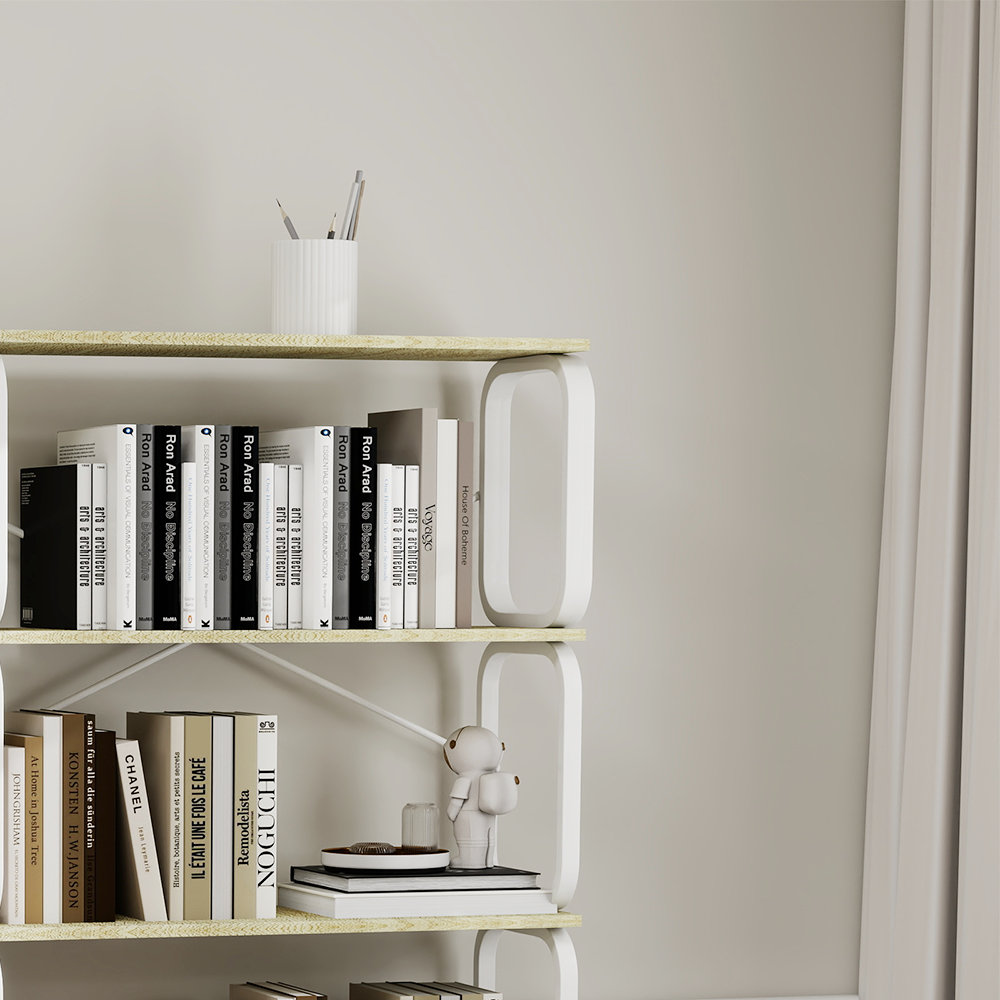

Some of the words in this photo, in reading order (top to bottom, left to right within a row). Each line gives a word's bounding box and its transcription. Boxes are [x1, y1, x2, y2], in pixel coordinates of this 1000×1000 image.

[141, 433, 152, 458] Ron
[165, 434, 177, 459] Ron
[219, 434, 230, 459] Ron
[243, 435, 254, 460] Ron
[338, 434, 349, 459] Ron
[362, 435, 373, 461] Ron
[141, 462, 152, 491] Arad
[165, 463, 177, 492] Arad
[219, 463, 230, 492] Arad
[243, 463, 254, 493] Arad
[338, 464, 349, 492] Arad
[362, 464, 373, 494] Arad
[79, 505, 90, 523] arts
[94, 506, 106, 523] arts
[165, 501, 177, 519] No
[243, 501, 254, 519] No
[361, 501, 373, 520] No
[462, 517, 469, 527] Of
[421, 504, 436, 552] Voyage
[79, 536, 92, 587] architecture
[94, 536, 107, 586] architecture
[163, 522, 177, 581] Discipline
[240, 522, 254, 582] Discipline
[359, 522, 373, 582] Discipline
[31, 755, 39, 767] At
[188, 757, 206, 782] CAFÉ
[31, 770, 39, 798] Home
[68, 752, 79, 815] KONSTEN
[87, 766, 96, 785] alla
[124, 754, 142, 814] CHANEL
[87, 787, 96, 802] die
[174, 798, 180, 806] et
[191, 784, 206, 796] LE
[31, 801, 38, 809] in
[191, 797, 206, 819] FOIS
[29, 811, 39, 843] Joshua
[173, 822, 181, 857] botanique,
[191, 821, 206, 840] UNE
[236, 789, 250, 866] Remodelista
[257, 769, 275, 888] NOGUCHI
[31, 845, 39, 866] Tree
[67, 825, 79, 909] H.W.JANSON
[188, 842, 205, 868] ÉTAIT
[191, 870, 205, 879] IL
